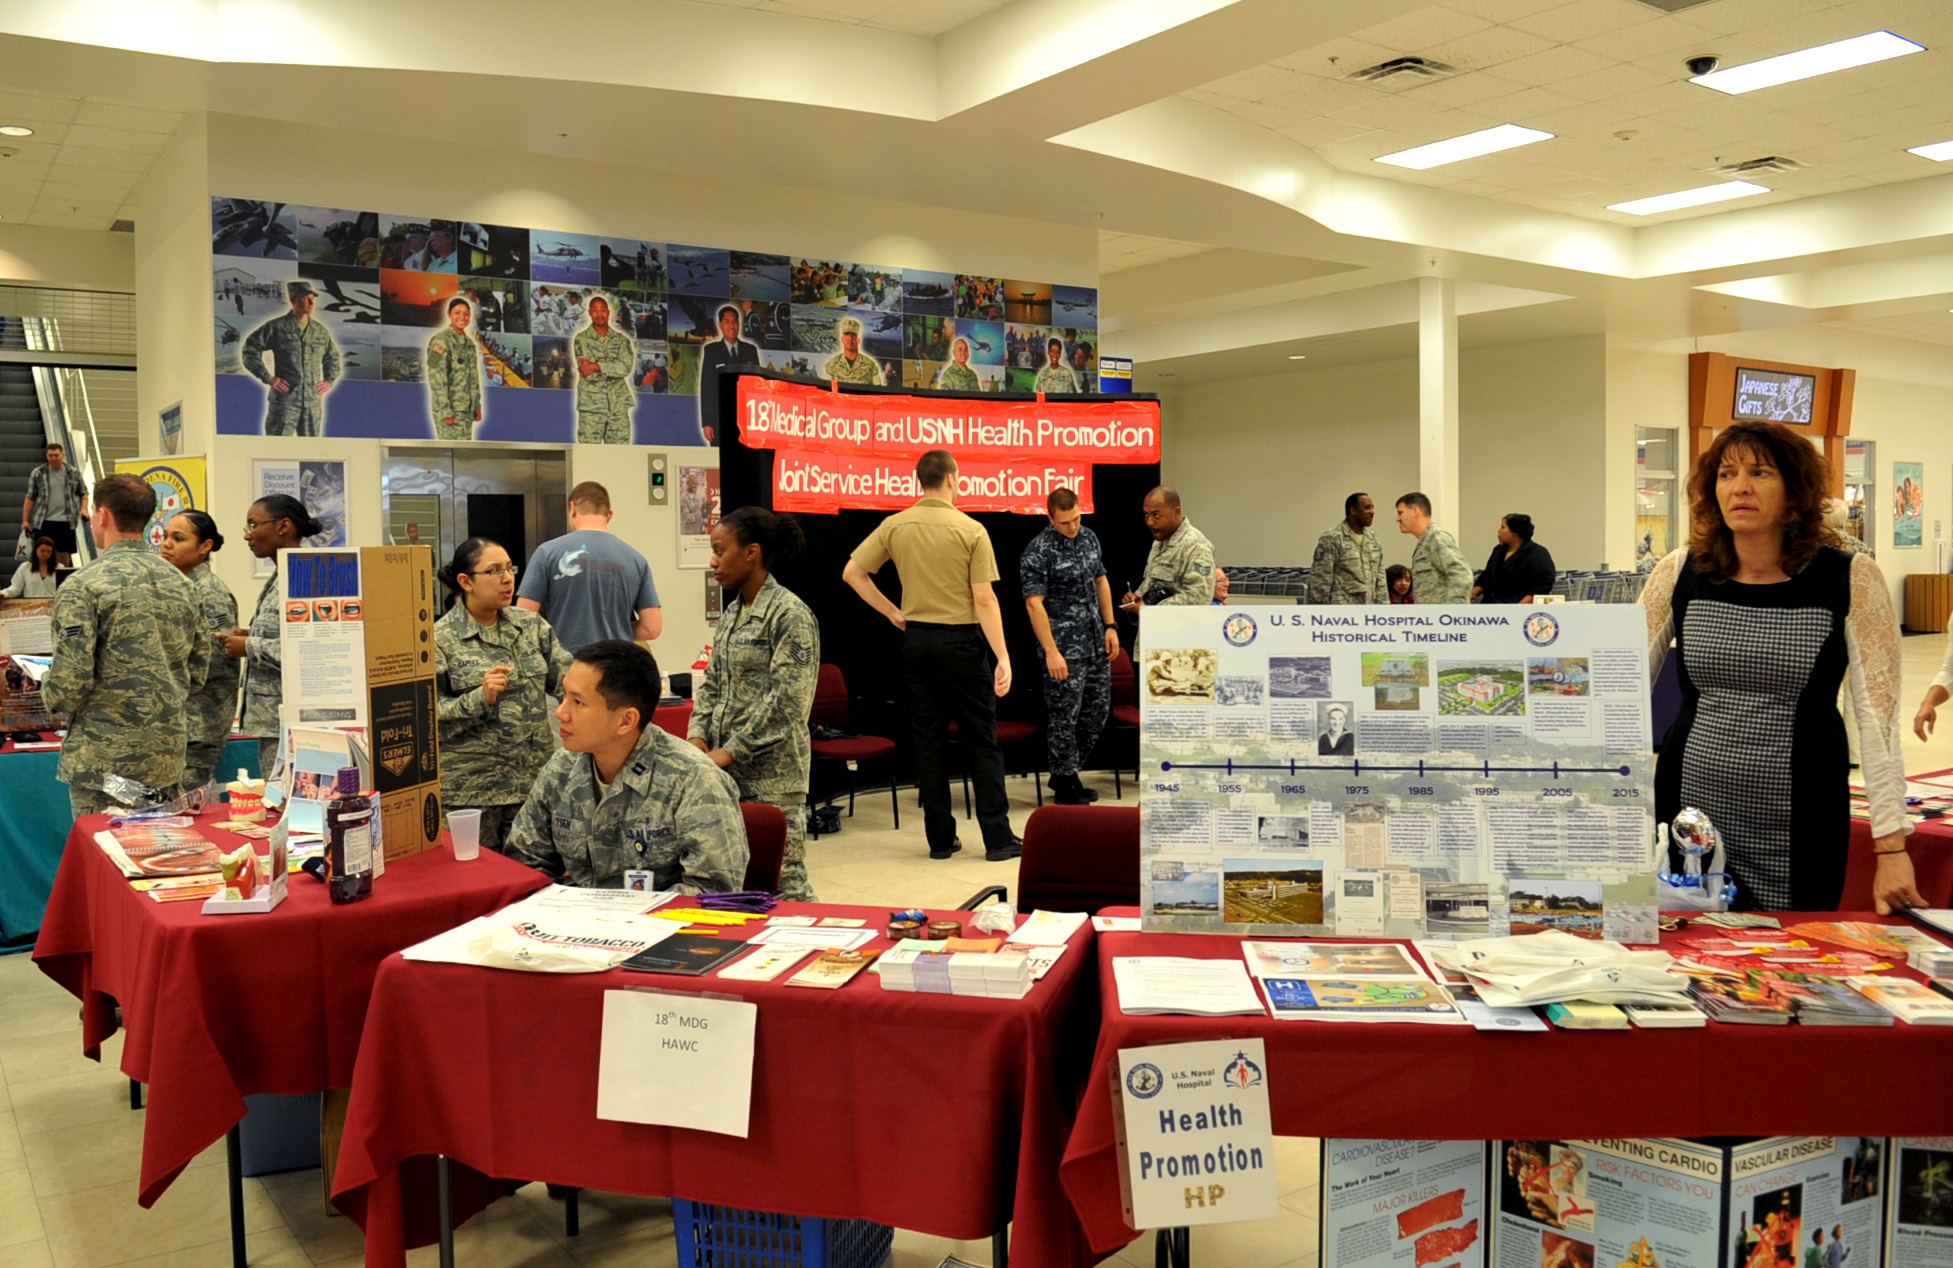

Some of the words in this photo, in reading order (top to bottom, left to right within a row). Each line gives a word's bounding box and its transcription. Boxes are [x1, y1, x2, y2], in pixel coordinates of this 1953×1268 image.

[1740, 374, 1779, 397] JAPANESE
[1738, 394, 1763, 415] GIFTS
[770, 401, 817, 438] Medical
[817, 410, 871, 445] Group
[875, 418, 904, 443] and
[906, 416, 964, 445] USNH
[968, 417, 1033, 447] Health
[1037, 419, 1154, 448] Promotion
[264, 472, 295, 481] Receive
[264, 481, 296, 489] Discount
[778, 458, 809, 493] Joint
[810, 464, 873, 496] Service
[875, 467, 925, 498] Heal
[957, 468, 1042, 498] omotion
[1044, 467, 1086, 496] Fair
[1270, 614, 1285, 627] U.
[1291, 614, 1305, 627] S.
[1311, 614, 1359, 627] NAVAL
[1365, 614, 1434, 627] HOSPITAL
[1439, 613, 1510, 626] OKINAWA
[1312, 631, 1397, 643] HISTORICAL
[1402, 630, 1468, 643] TIMELINE
[303, 710, 352, 720] FLOSSING
[381, 724, 414, 743] Tri-Fold
[383, 745, 411, 759] ELMER'S
[1155, 783, 1180, 793] 1945
[1217, 784, 1242, 793] 1955
[1280, 785, 1306, 794] 1965
[1345, 786, 1370, 795] 1975
[1408, 786, 1434, 796] 1985
[1474, 787, 1500, 797] 1995
[1542, 788, 1573, 797] 2005
[1612, 788, 1640, 798] 2015
[655, 1010, 677, 1026] 18th
[679, 1016, 708, 1030] MDG
[661, 1037, 699, 1053] HAWC
[1171, 1071, 1189, 1080] U.S.
[1191, 1068, 1215, 1078] Naval
[1176, 1079, 1212, 1090] Hospital
[1159, 1103, 1243, 1134] Health
[1140, 1142, 1264, 1180] Promotion
[1375, 1145, 1416, 1168] DISEASE?
[1658, 1150, 1719, 1176] CARDIO
[1734, 1148, 1789, 1173] VASCULAR
[1791, 1137, 1833, 1159] DISEASE
[1331, 1184, 1344, 1193] The
[1344, 1179, 1360, 1189] Work
[1361, 1176, 1368, 1184] of
[1369, 1172, 1383, 1182] Your
[1383, 1168, 1401, 1178] Heart
[1588, 1170, 1624, 1188] Smoking
[1596, 1158, 1620, 1176] RISK
[1624, 1166, 1682, 1192] FACTORS
[1684, 1182, 1714, 1200] YOU
[1184, 1183, 1226, 1209] HP
[1372, 1194, 1407, 1215] MAJOR
[1408, 1184, 1439, 1203] KILLERS
